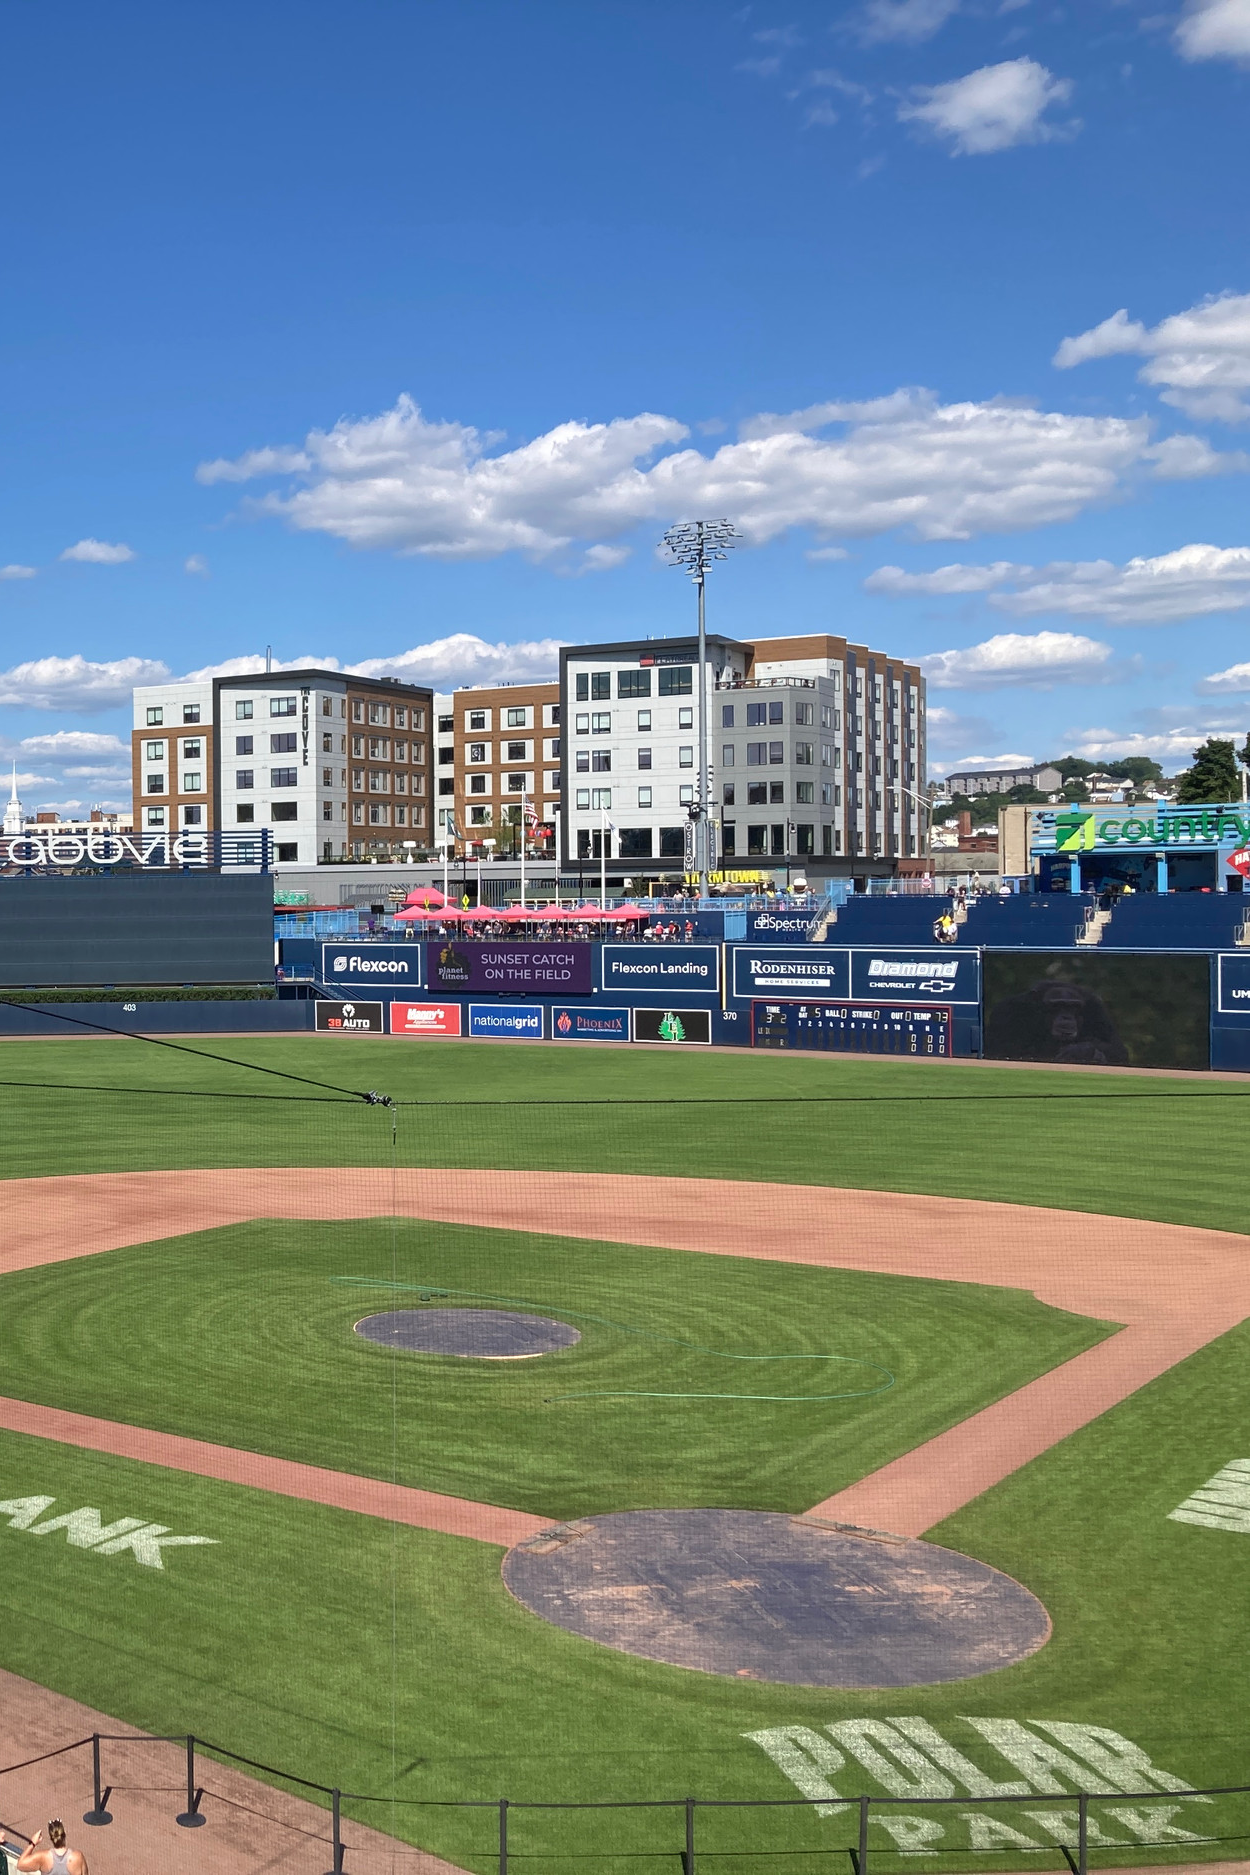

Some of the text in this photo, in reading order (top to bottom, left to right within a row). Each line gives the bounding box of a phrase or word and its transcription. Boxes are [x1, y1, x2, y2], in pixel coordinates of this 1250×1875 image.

[7, 829, 208, 865] abbvie
[685, 822, 694, 870] OSTROW
[685, 869, 759, 884] WRMTOWN
[481, 954, 575, 965] SUNSET CATCH
[438, 967, 463, 976] planet
[612, 961, 708, 977] Flexcon Landing
[750, 960, 835, 975] RODENHISER
[868, 959, 959, 977] Diamond
[485, 968, 571, 980] ON THE FIELD
[123, 1003, 136, 1012] 403
[766, 1006, 781, 1014] TIME
[723, 1012, 737, 1021] 370
[825, 1008, 847, 1019] BALL 0
[852, 1010, 880, 1020] STRIKE 0
[890, 1011, 911, 1021] OUT 0
[913, 1012, 931, 1020] TEMP
[343, 1019, 370, 1028] AUTO
[474, 1014, 538, 1029] nationalgrid
[740, 1715, 1214, 1818] POLAR
[869, 1804, 1222, 1857] PARK
